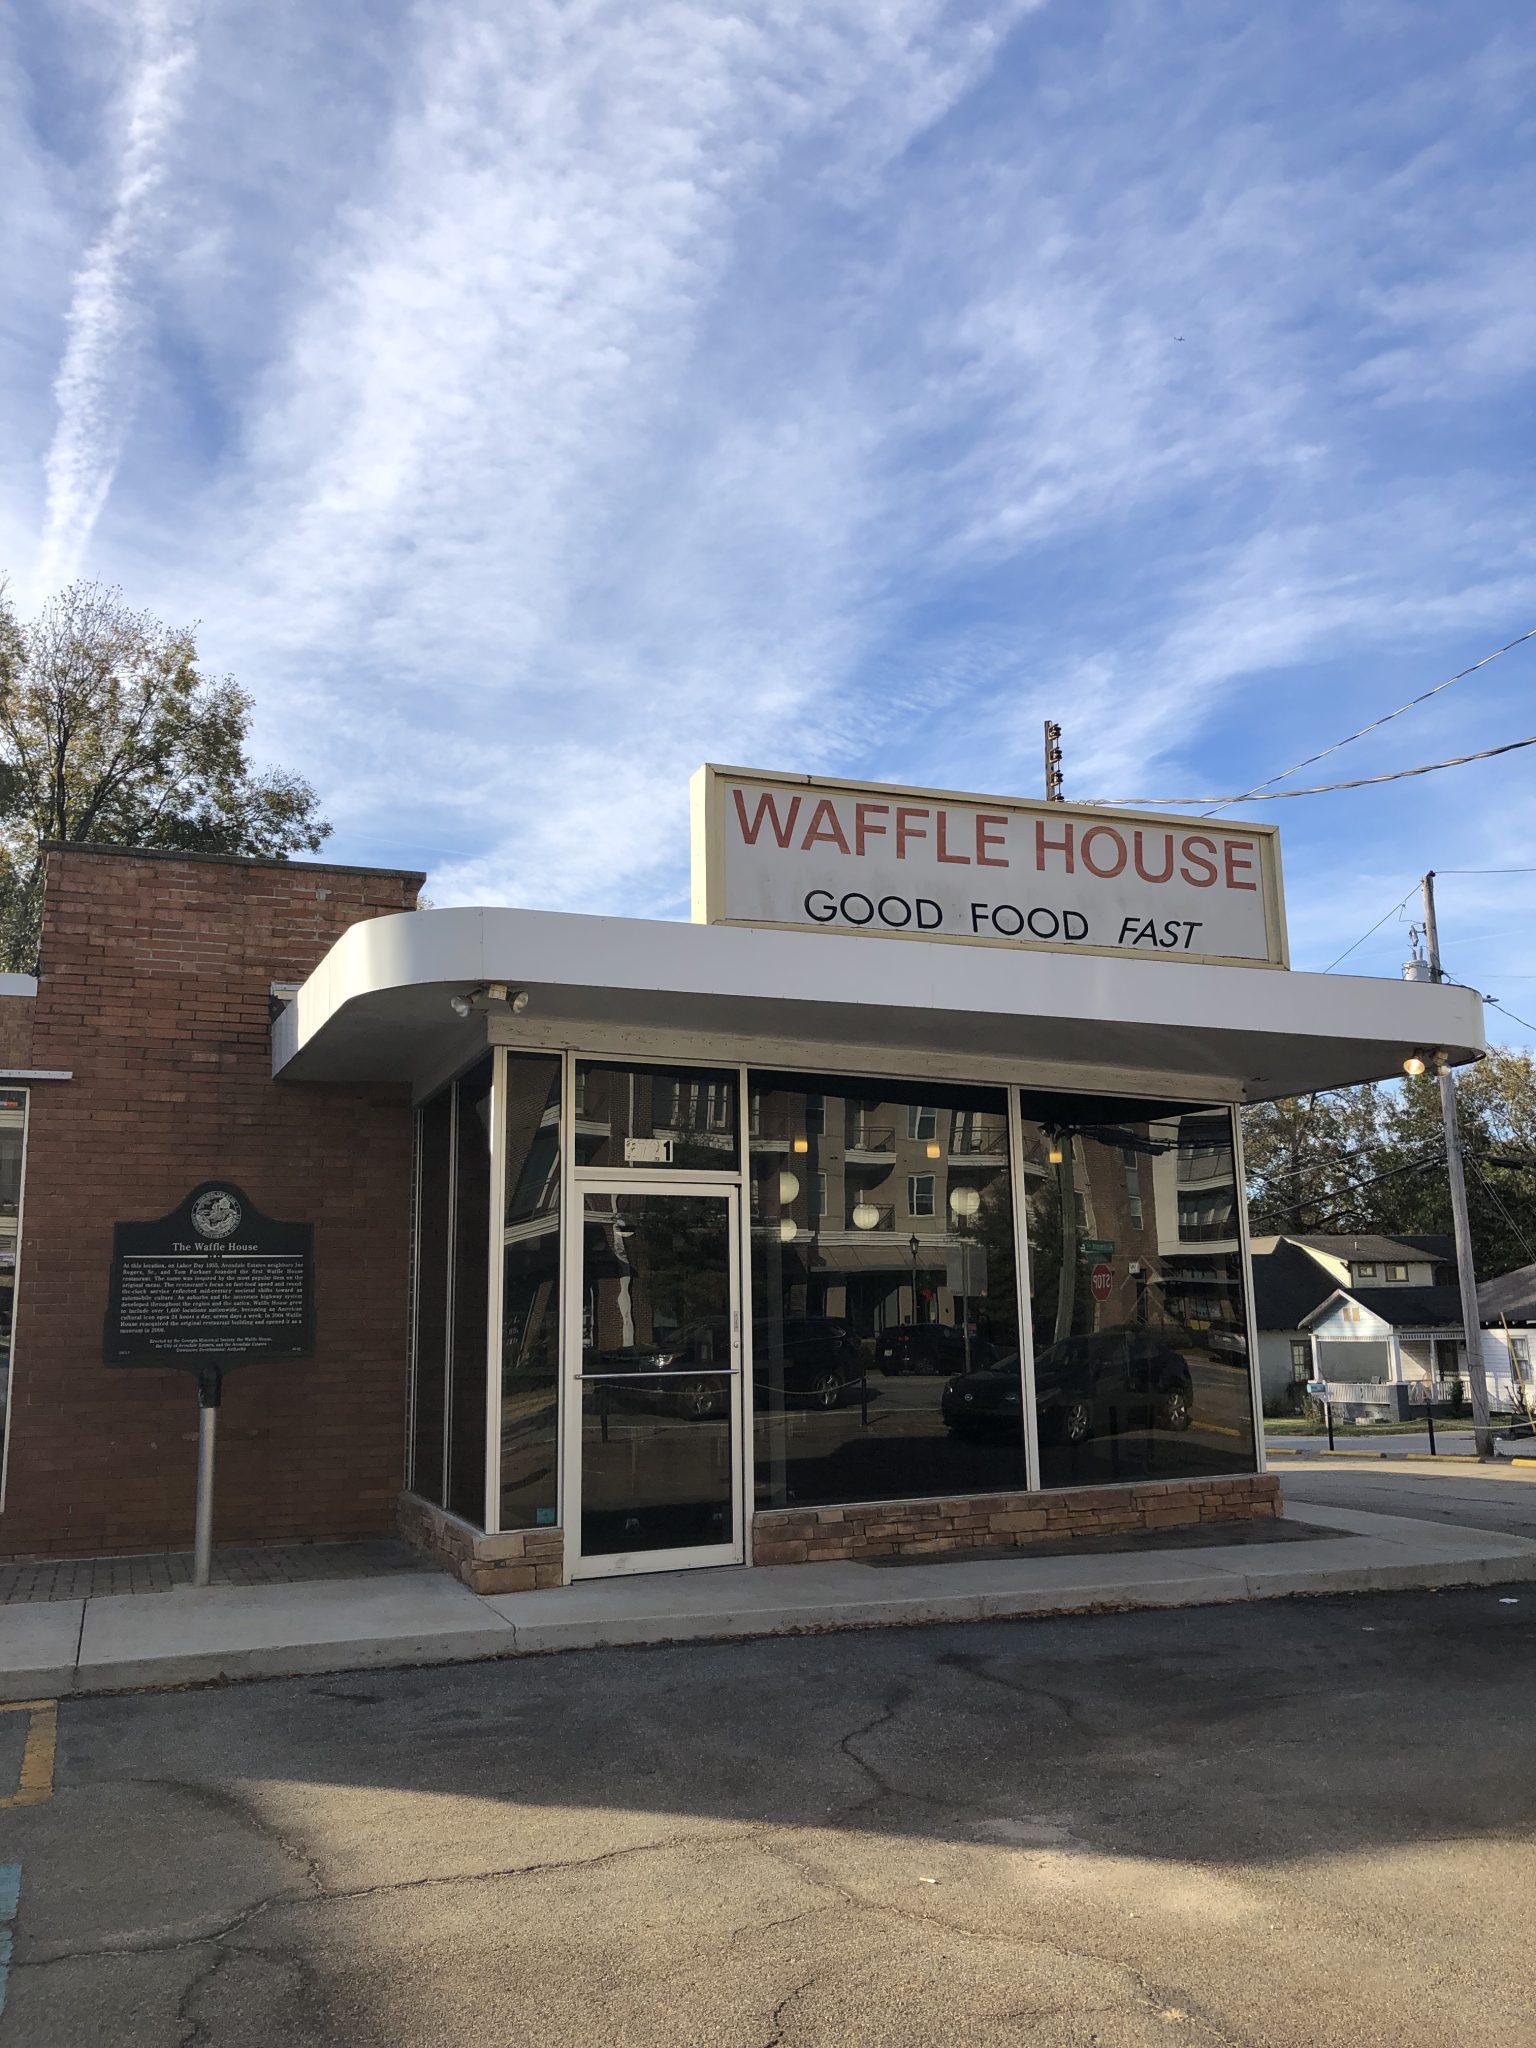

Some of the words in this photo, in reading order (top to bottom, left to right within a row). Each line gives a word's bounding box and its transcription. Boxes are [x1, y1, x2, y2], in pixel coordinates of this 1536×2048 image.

[732, 788, 1009, 868] WAFFLE
[1034, 820, 1258, 891] HOUSE
[804, 889, 943, 929] GOOD
[971, 903, 1089, 940] FOOD
[1118, 917, 1203, 949] FAST
[172, 1242, 191, 1251] The
[194, 1242, 225, 1251] Waffle
[228, 1242, 258, 1251] House
